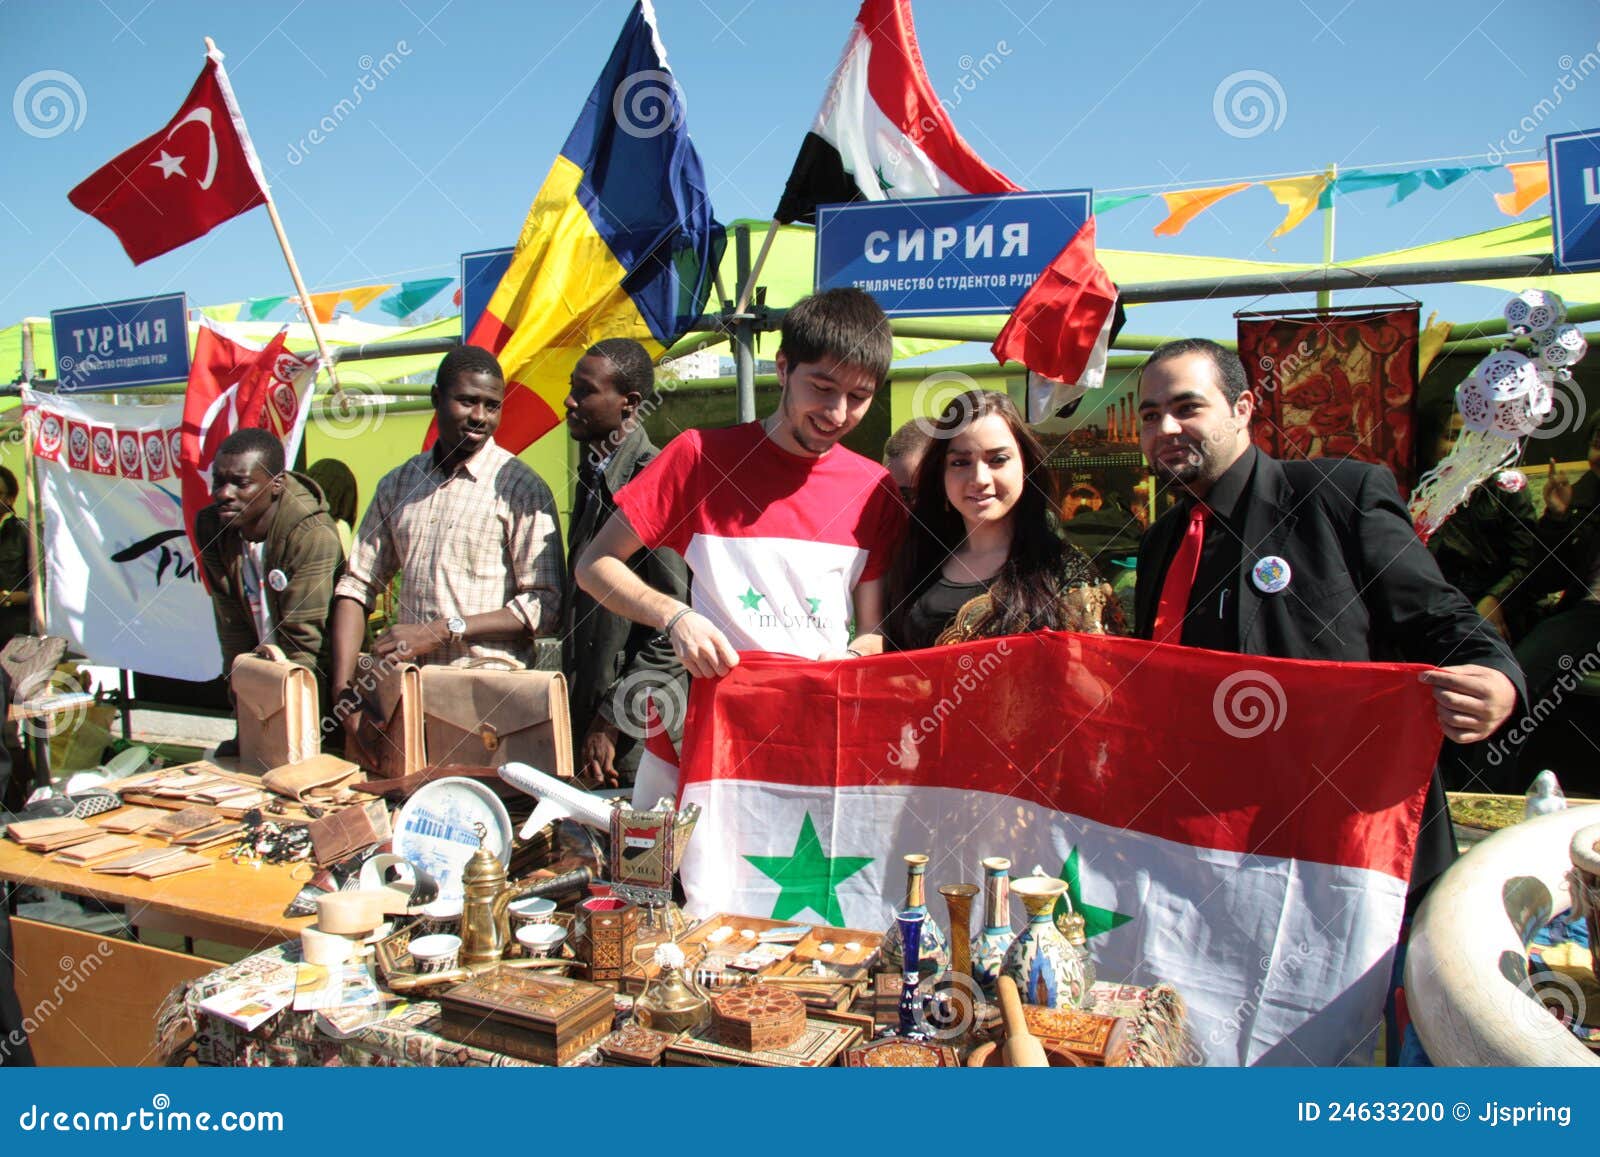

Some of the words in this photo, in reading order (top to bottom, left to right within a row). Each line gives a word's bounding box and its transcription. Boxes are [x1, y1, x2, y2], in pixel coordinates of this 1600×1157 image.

[864, 222, 1029, 264] СИРИЯ
[937, 274, 1006, 290] СТУДЕНТОВ
[72, 318, 168, 353] ТУРЦИЯ
